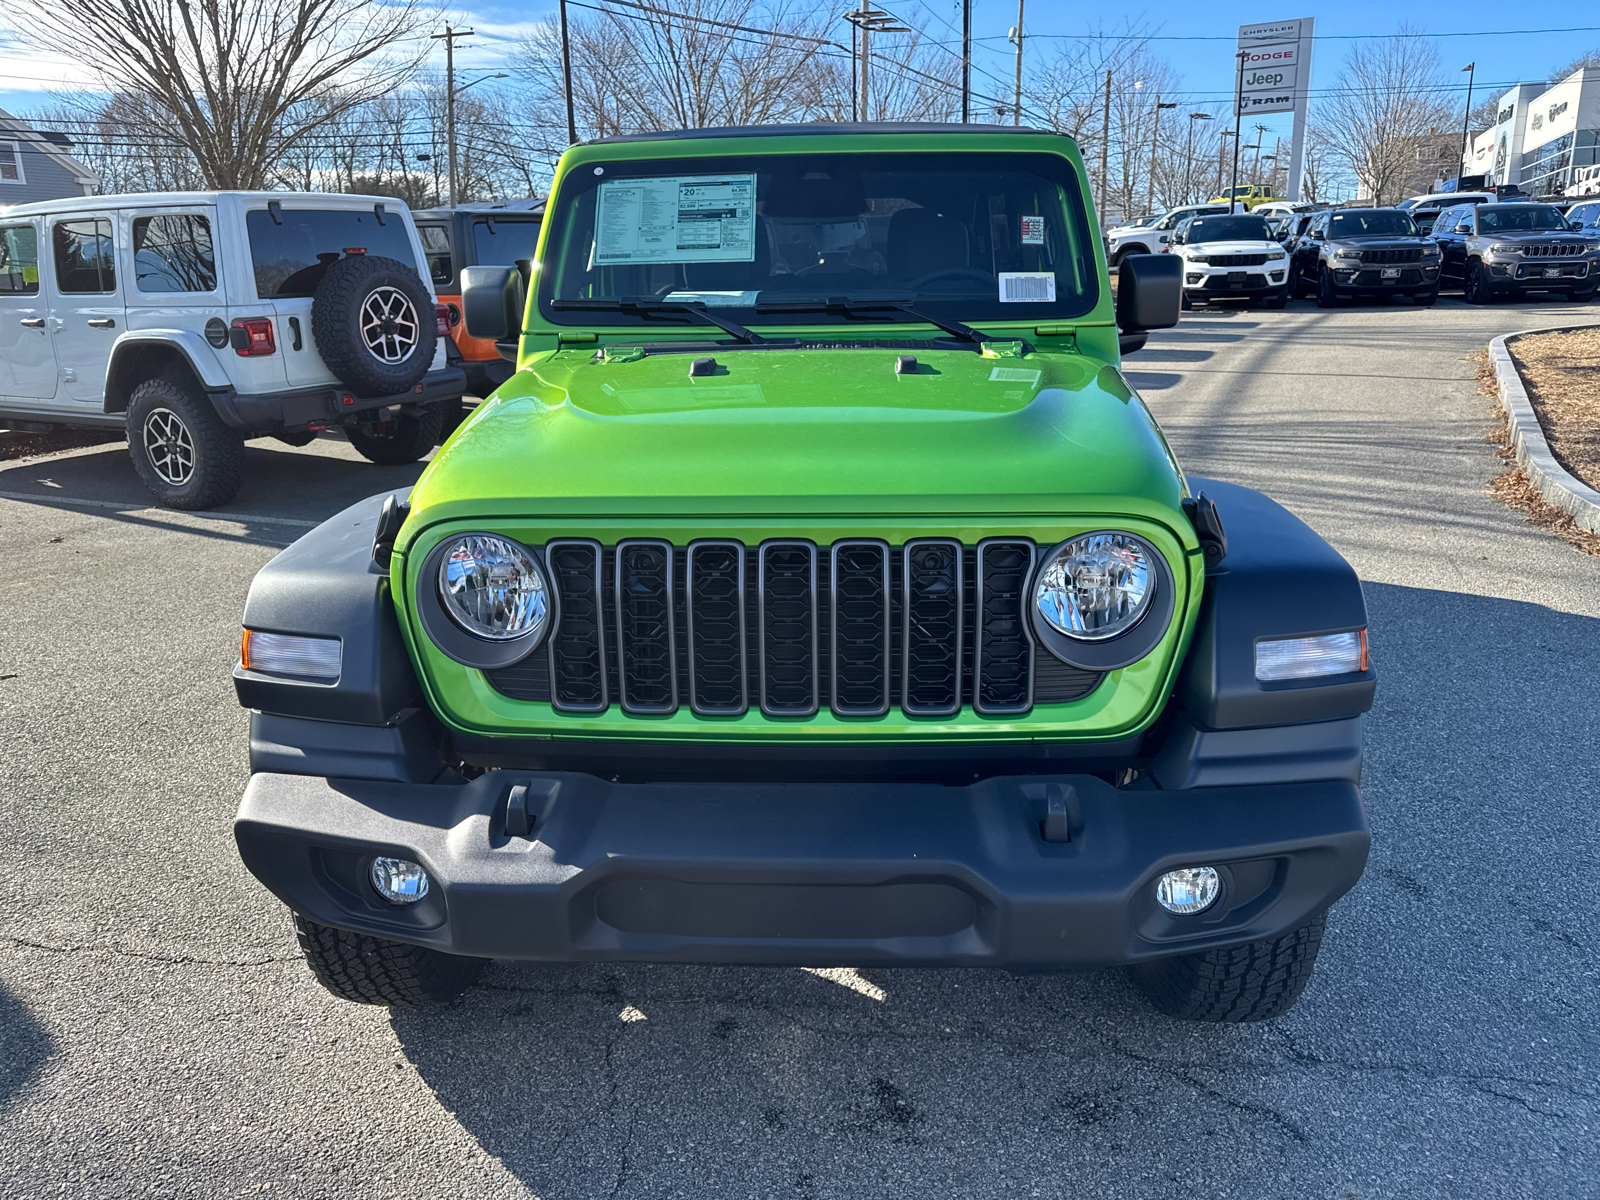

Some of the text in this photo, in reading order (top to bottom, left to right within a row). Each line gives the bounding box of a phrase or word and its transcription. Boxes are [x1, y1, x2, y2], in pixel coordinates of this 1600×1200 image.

[1243, 26, 1294, 35] CHRYSLER
[1246, 73, 1284, 86] Jeep
[1252, 96, 1290, 105] RAM
